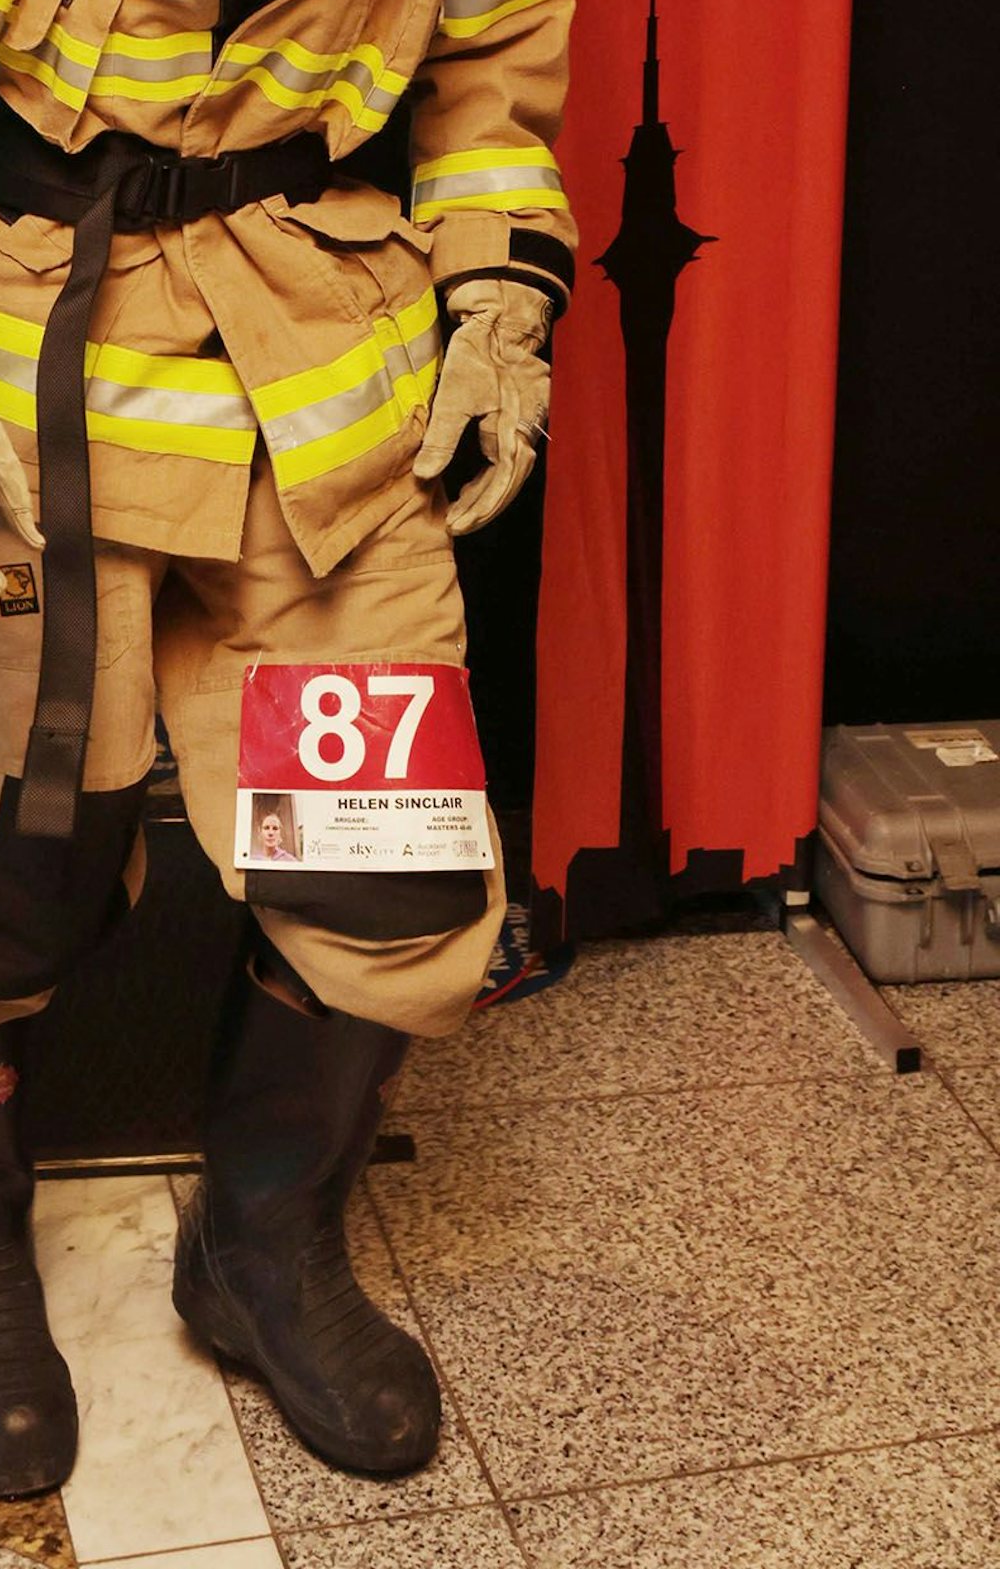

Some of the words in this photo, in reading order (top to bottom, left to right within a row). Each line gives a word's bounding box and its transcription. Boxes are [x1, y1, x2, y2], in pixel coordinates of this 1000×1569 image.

[4, 600, 35, 612] LION
[297, 673, 436, 782] 87
[338, 797, 389, 810] HELEN
[394, 796, 463, 810] SINCLAIR
